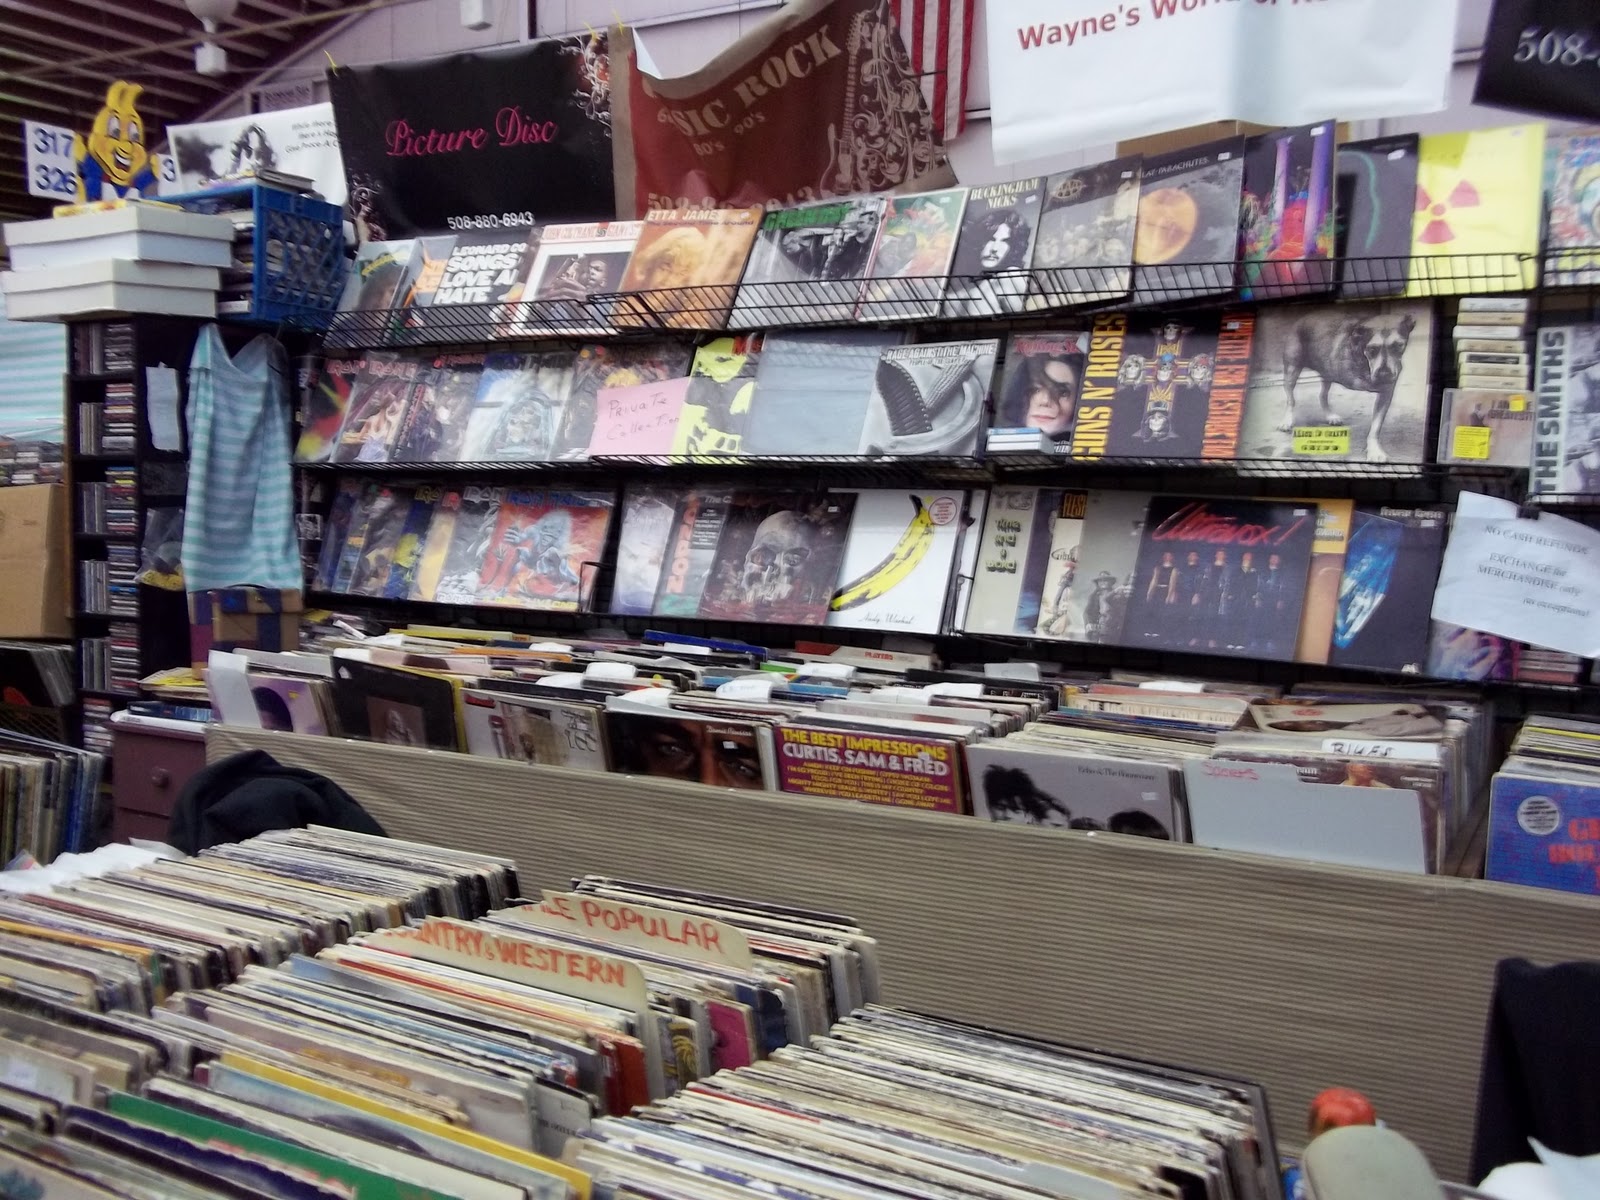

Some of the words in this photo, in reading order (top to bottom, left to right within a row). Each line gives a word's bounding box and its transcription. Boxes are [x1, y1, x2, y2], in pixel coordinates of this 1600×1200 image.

[1017, 5, 1140, 50] Wayne's
[733, 24, 841, 108] ROCK
[34, 127, 74, 158] 317
[386, 118, 489, 157] Picture
[495, 106, 559, 147] Disc
[34, 164, 77, 195] 326
[970, 177, 1040, 200] BUCKINGHAM
[646, 209, 677, 220] ETTA
[986, 194, 1017, 210] NICKS
[447, 211, 536, 230] 508-880-6943
[446, 253, 520, 272] SONGS
[440, 270, 494, 288] LOVE
[434, 286, 492, 304] HATE
[1085, 313, 1129, 378] ROSES
[1537, 330, 1566, 439] SMITHS
[1072, 406, 1114, 461] GUNS
[1530, 441, 1559, 493] THE
[1484, 524, 1501, 536] NO
[1502, 529, 1533, 543] CASH
[1489, 552, 1552, 574] EXCHANGE
[781, 728, 808, 742] THE
[811, 732, 843, 748] BEST
[846, 737, 947, 760] IMPRESSIONS
[783, 742, 843, 764] CURTIS,
[845, 750, 886, 769] SAM
[889, 756, 902, 770] &
[904, 757, 949, 775] FRED
[581, 899, 724, 953] POPULAR
[494, 936, 625, 987] WESTERN
